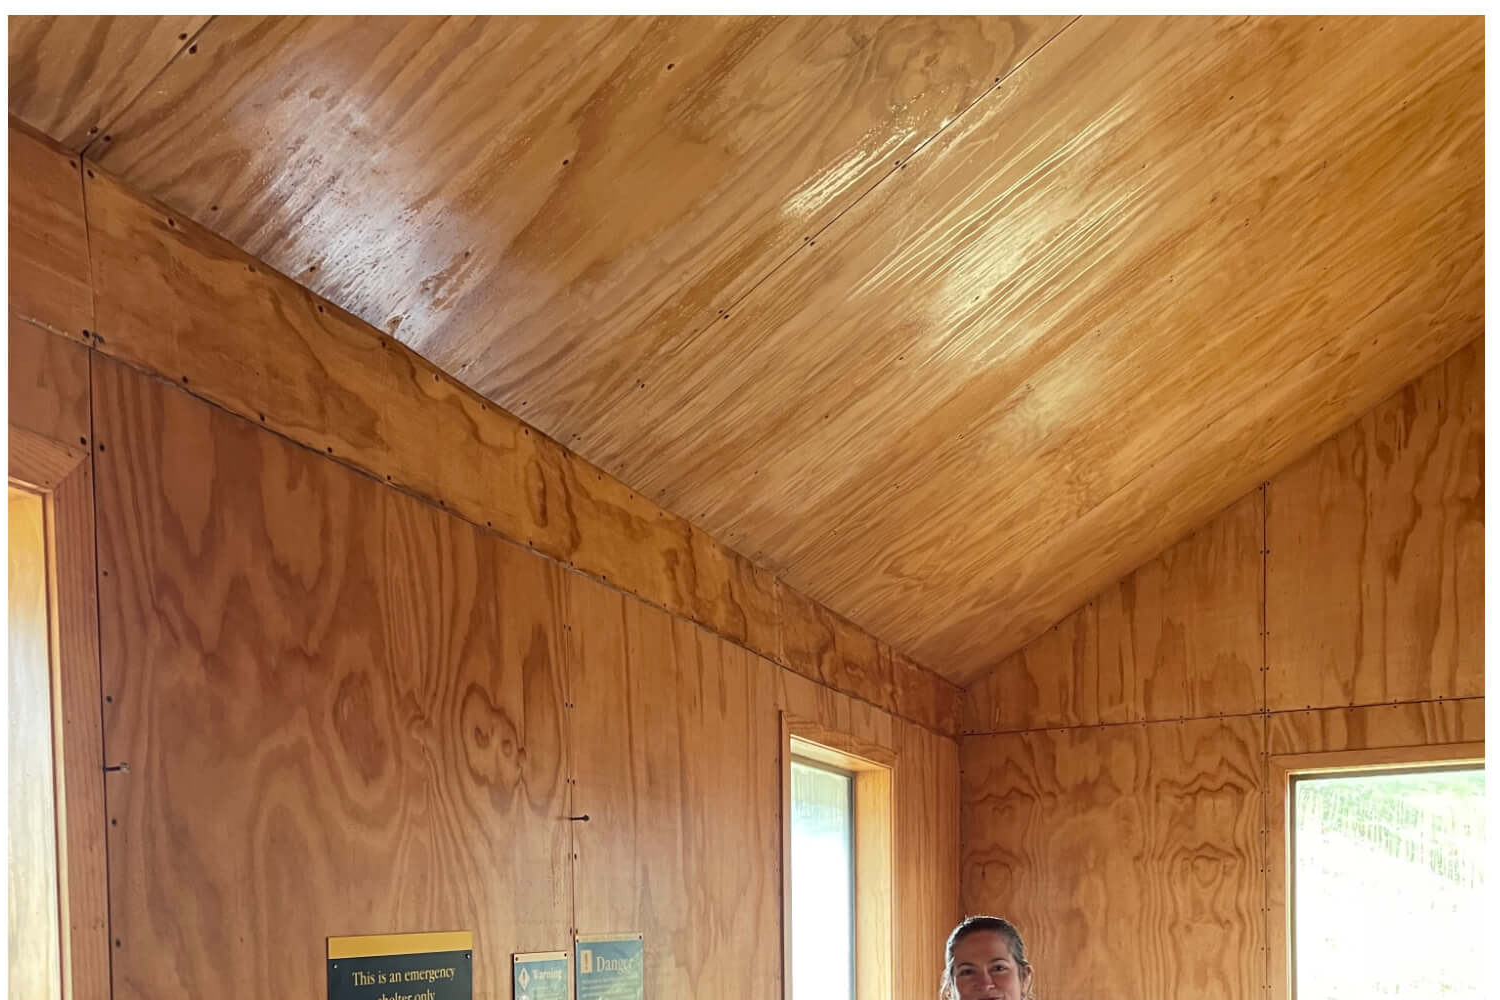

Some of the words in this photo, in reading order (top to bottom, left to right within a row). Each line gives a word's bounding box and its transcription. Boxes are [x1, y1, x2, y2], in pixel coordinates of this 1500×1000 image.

[595, 955, 635, 976] Dange
[352, 971, 375, 986] This
[378, 971, 387, 984] is
[389, 971, 402, 983] an
[404, 967, 456, 983] emergency
